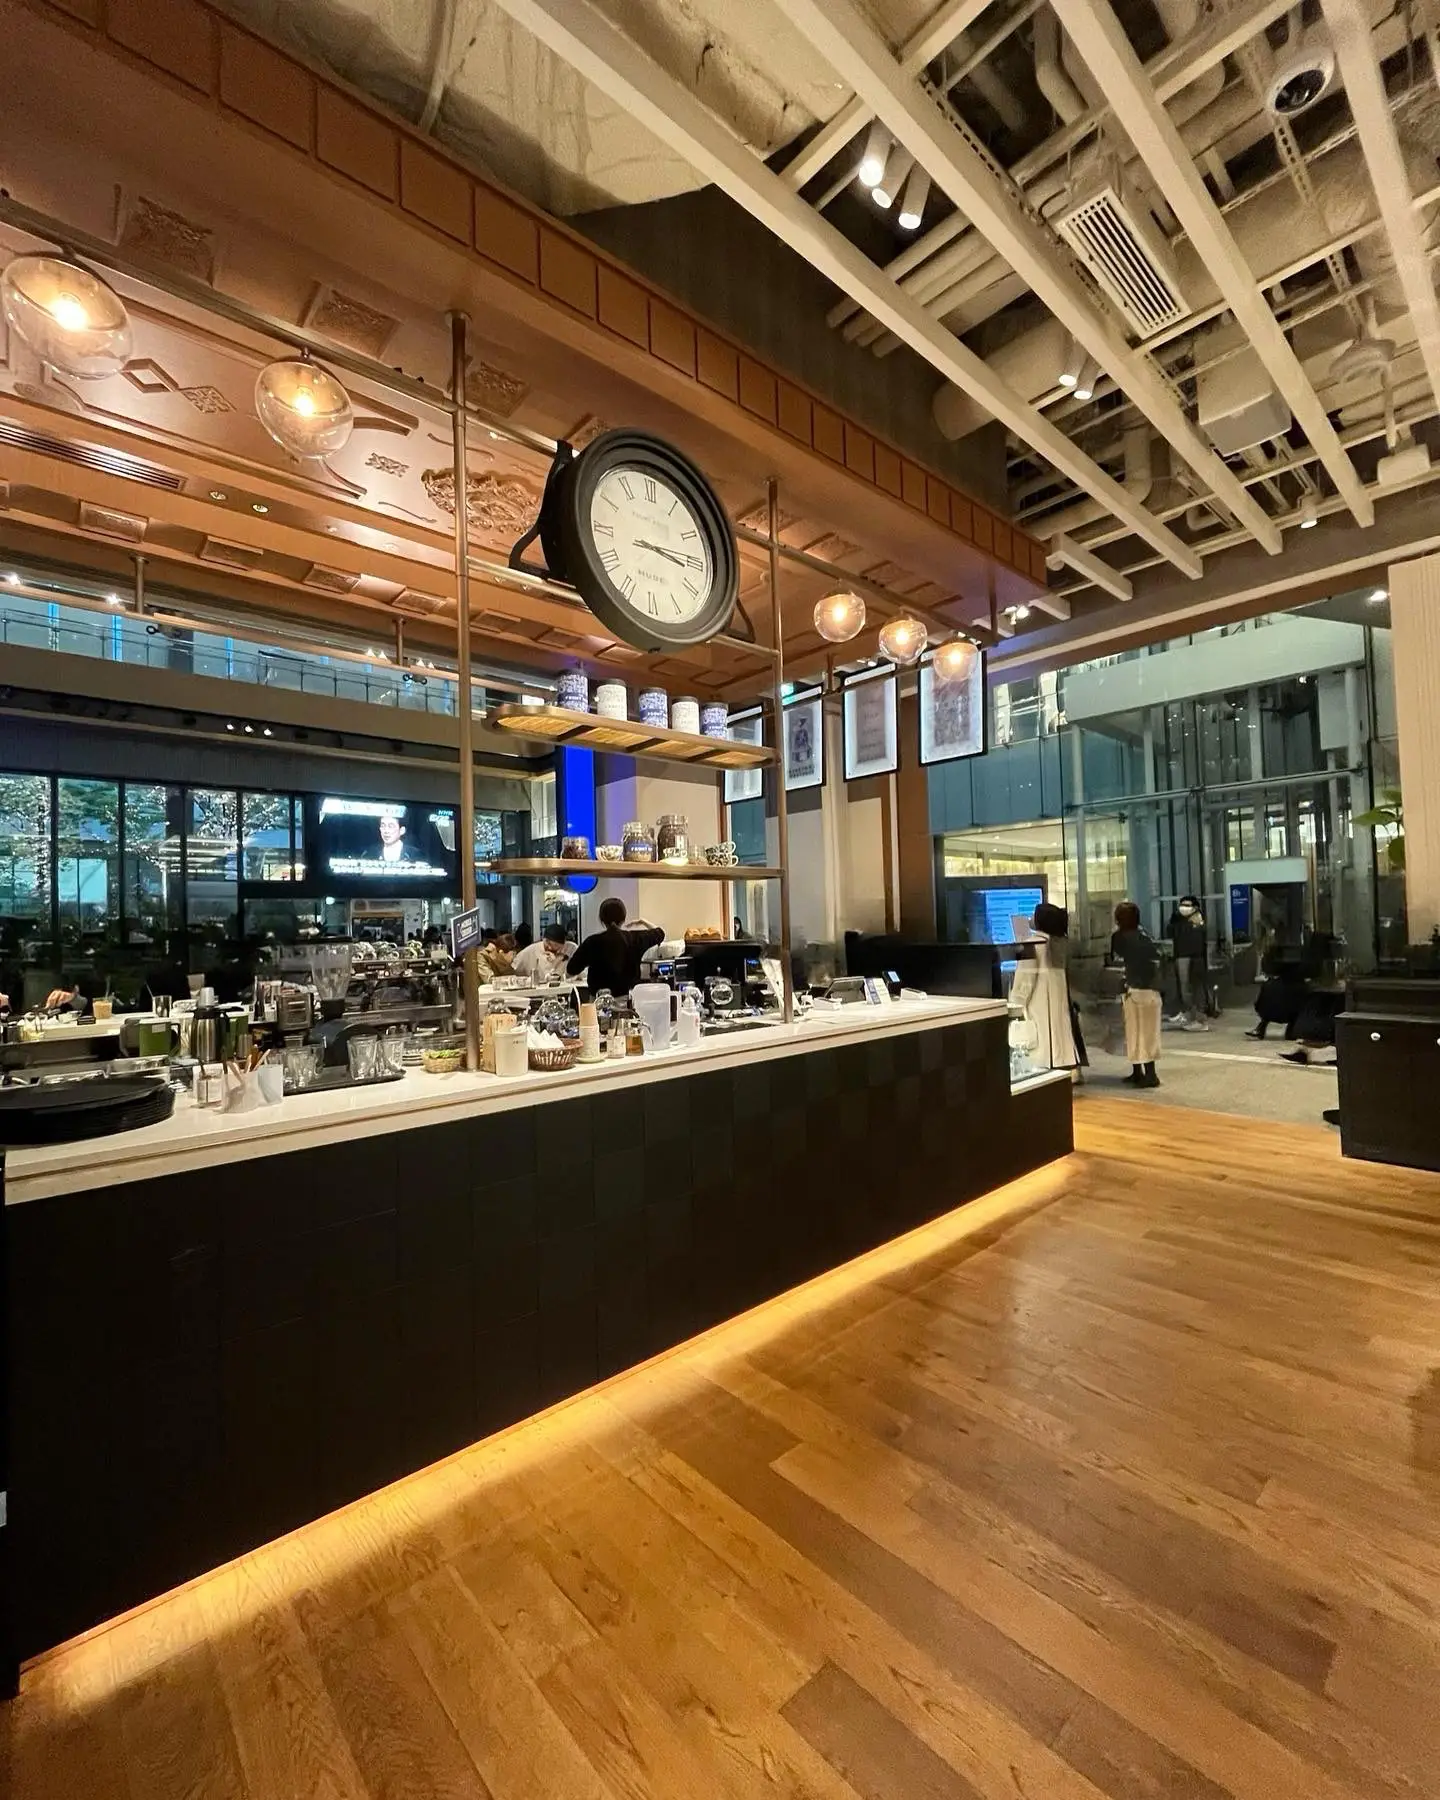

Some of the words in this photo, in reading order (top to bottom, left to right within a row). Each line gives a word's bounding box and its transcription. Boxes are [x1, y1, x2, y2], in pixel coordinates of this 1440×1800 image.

[644, 477, 657, 503] XII
[668, 500, 678, 517] I
[681, 530, 697, 541] II
